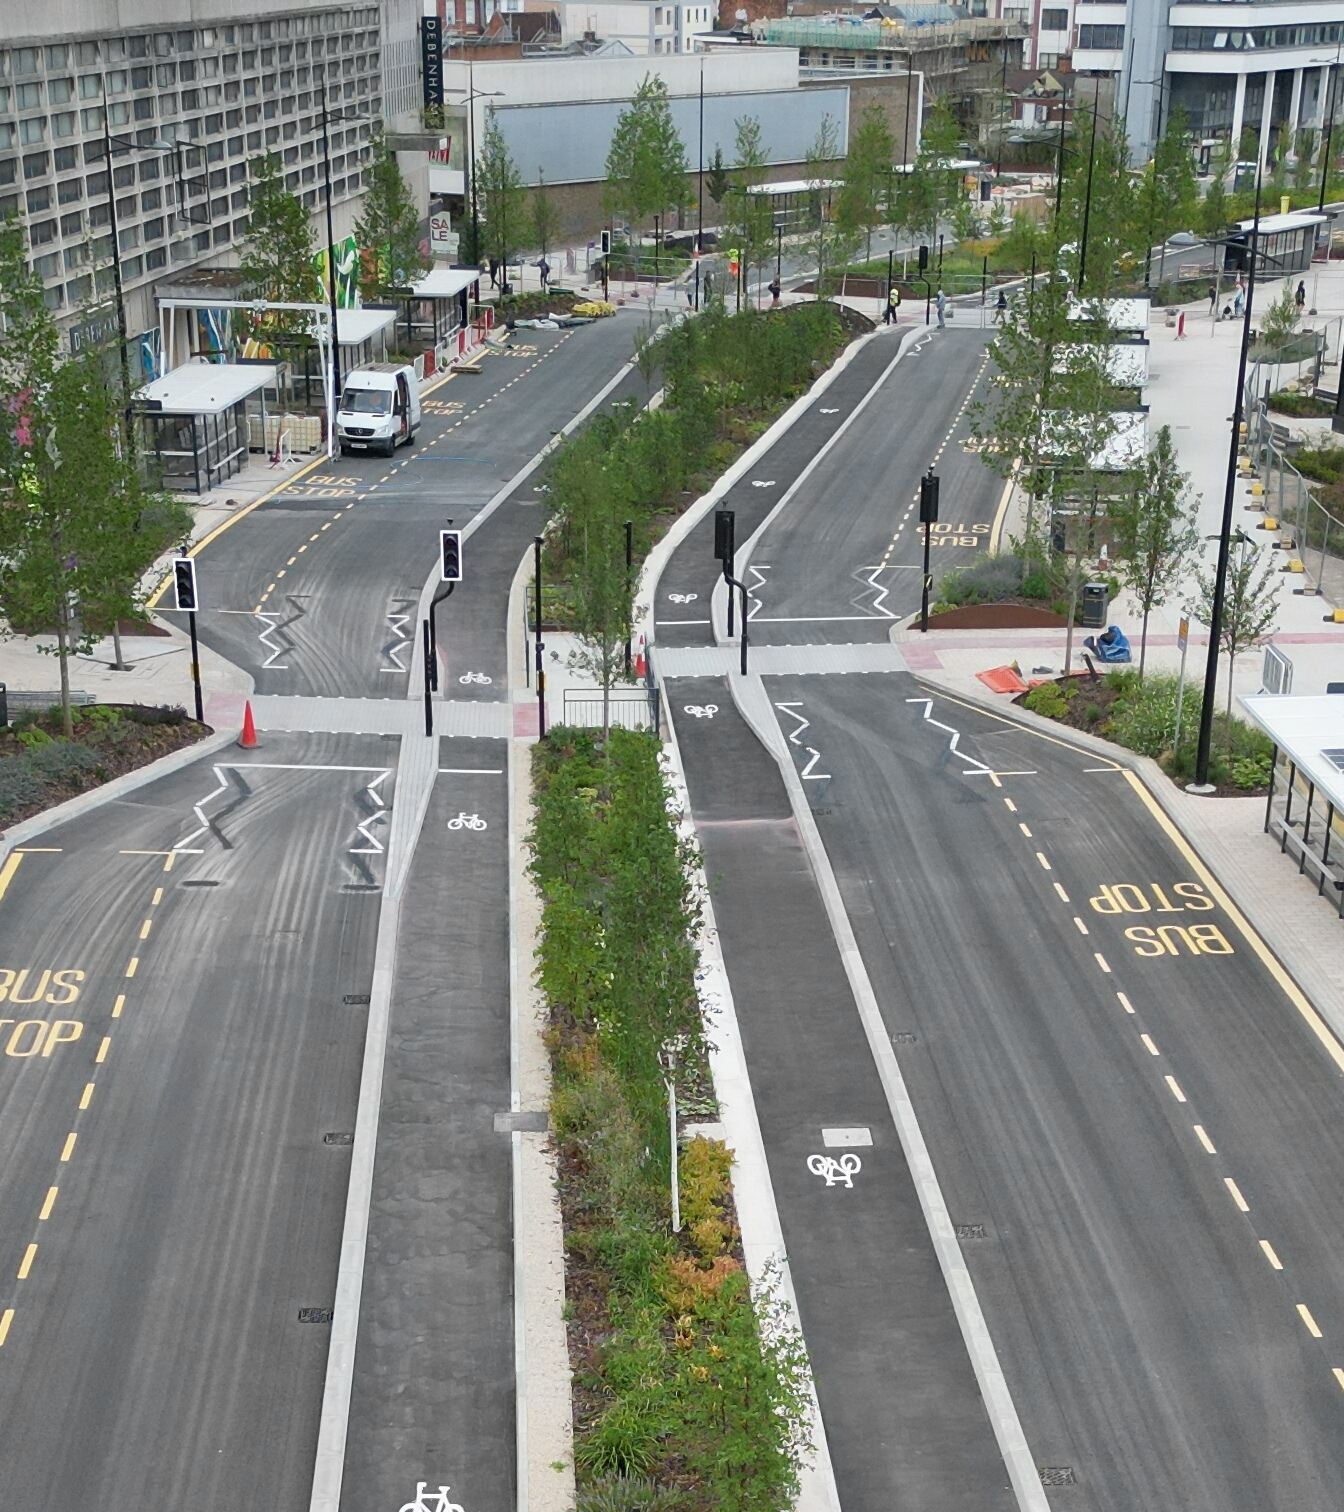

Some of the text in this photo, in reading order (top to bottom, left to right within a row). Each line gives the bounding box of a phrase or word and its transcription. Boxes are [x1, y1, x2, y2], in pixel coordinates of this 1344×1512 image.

[426, 20, 439, 116] DEBENHAM
[423, 407, 464, 416] TOP
[304, 475, 363, 487] BUS
[282, 485, 356, 498] STOP
[916, 523, 991, 534] STOP
[921, 536, 978, 547] BUS
[1089, 882, 1215, 914] STOP
[1124, 924, 1234, 957] BUS
